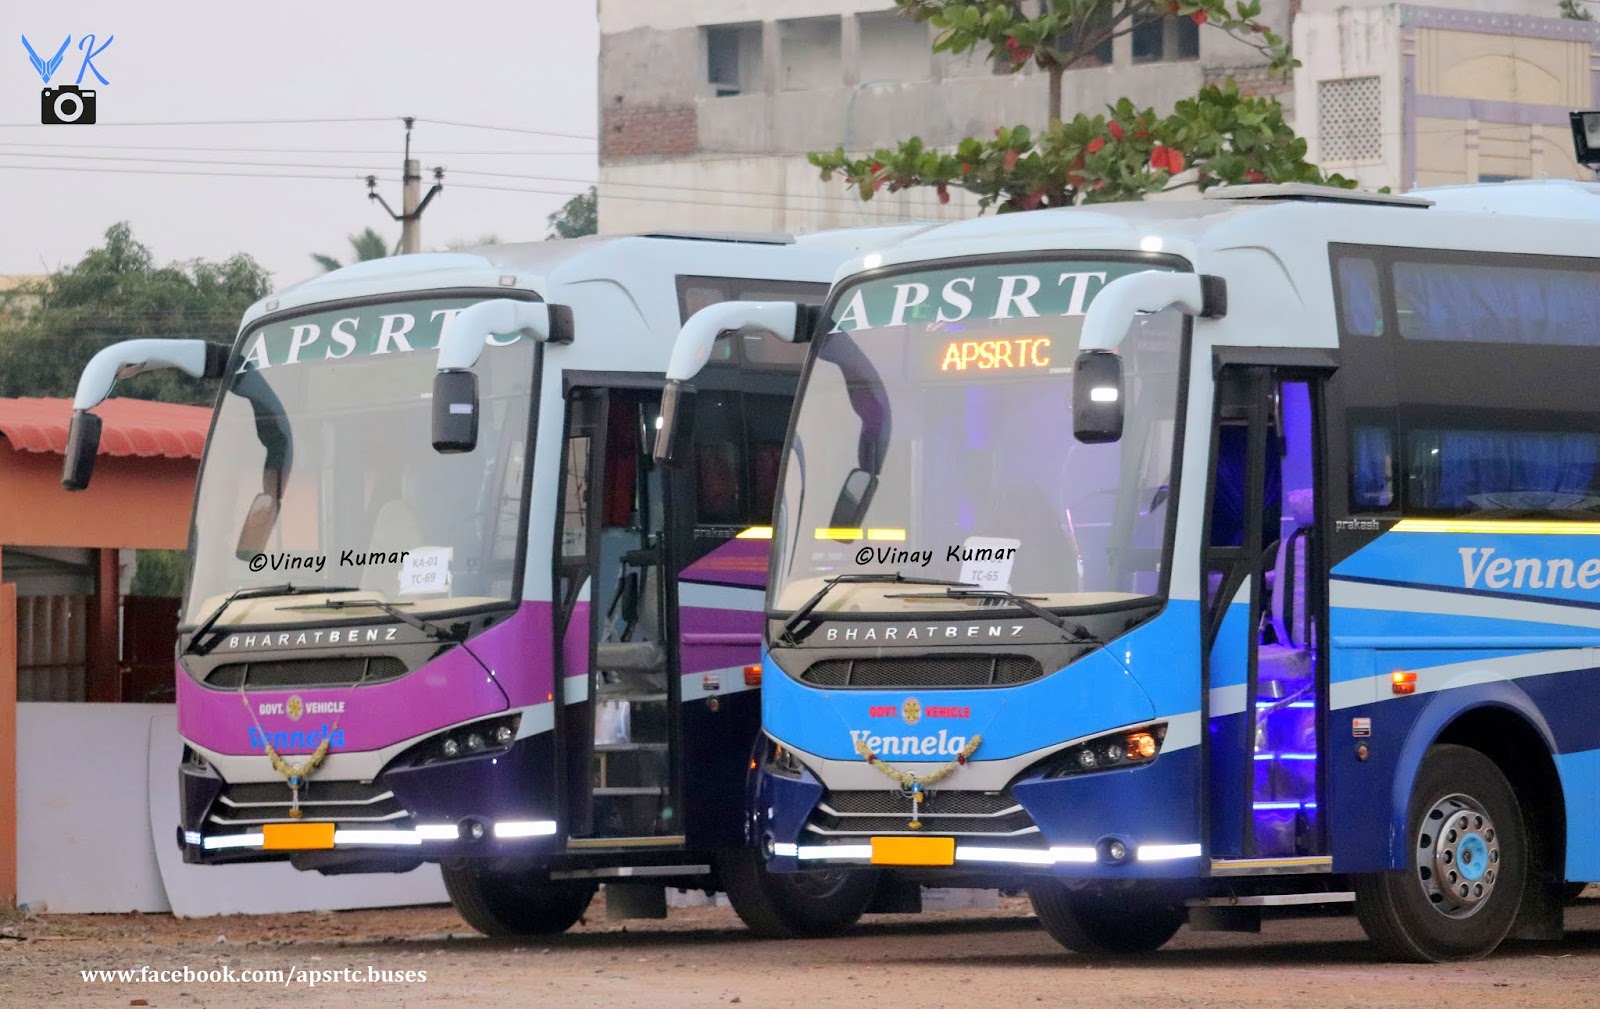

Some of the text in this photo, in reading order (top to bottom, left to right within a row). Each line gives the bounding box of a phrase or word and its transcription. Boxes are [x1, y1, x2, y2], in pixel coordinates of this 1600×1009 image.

[825, 270, 1153, 335] APSRT
[941, 338, 1051, 371] APSRTC
[1335, 519, 1380, 532] prakash
[412, 556, 439, 568] KA-01
[411, 572, 436, 584] TC-69
[971, 570, 999, 581] TC-65
[228, 628, 398, 649] BHARATBENZ
[827, 625, 1024, 641] BHARATBENZ
[259, 702, 345, 715] GOVT. VEHICLE
[869, 706, 971, 718] GOVT. VEHICLE
[850, 729, 968, 755] Vennela
